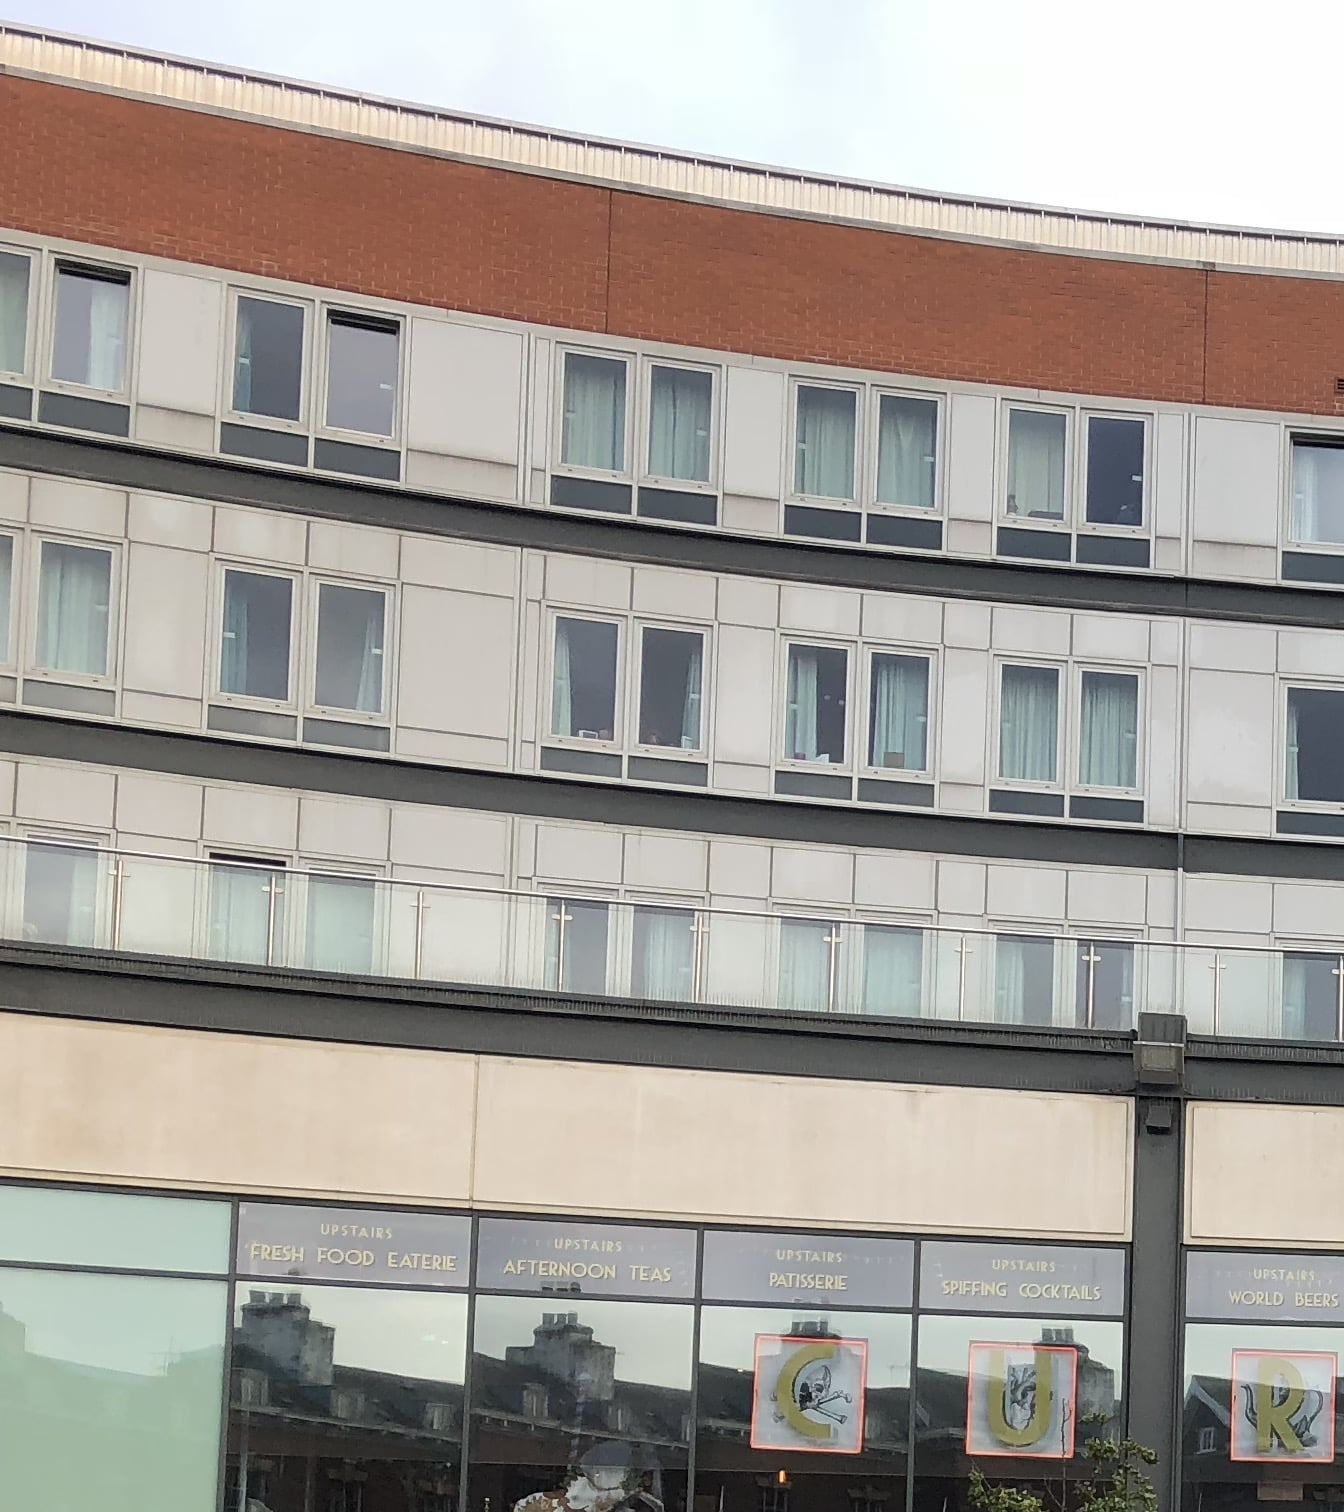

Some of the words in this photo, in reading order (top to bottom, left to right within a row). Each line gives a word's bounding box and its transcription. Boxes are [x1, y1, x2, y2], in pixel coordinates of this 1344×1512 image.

[320, 1224, 393, 1239] UPSTAIRS
[554, 1238, 623, 1253] UPSTAIRS
[250, 1244, 305, 1262] FRESH
[317, 1247, 375, 1266] FOOD
[387, 1252, 457, 1272] EATERIE
[776, 1249, 843, 1264] UPSTAIRS
[503, 1260, 617, 1280] AFTERNOON
[629, 1265, 671, 1283] TEAS
[992, 1260, 1056, 1273] UPSTAIRS
[769, 1272, 848, 1291] PATISSERIE
[1254, 1269, 1315, 1282] UPSTAIRS
[942, 1280, 1008, 1298] SPIFFING
[1019, 1283, 1101, 1300] COCKTAILS
[1229, 1290, 1284, 1307] WORLD
[1295, 1292, 1340, 1308] BEERS
